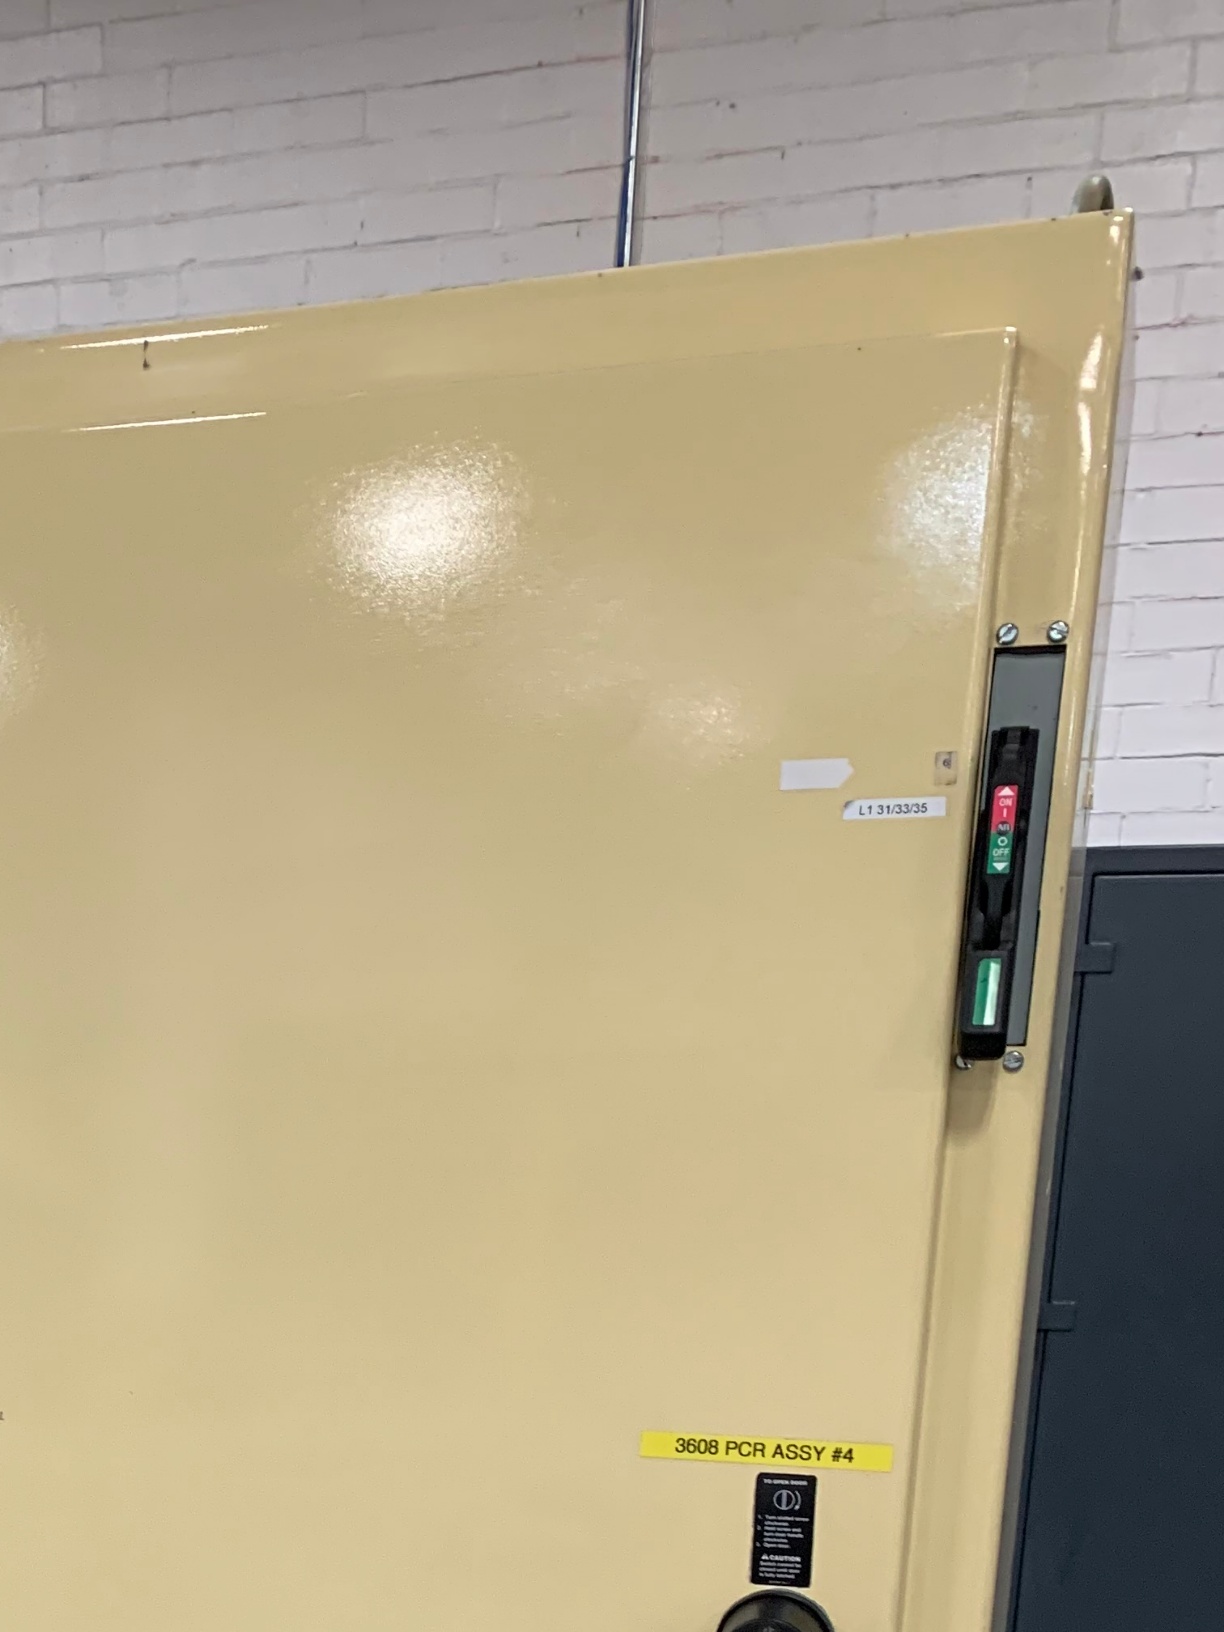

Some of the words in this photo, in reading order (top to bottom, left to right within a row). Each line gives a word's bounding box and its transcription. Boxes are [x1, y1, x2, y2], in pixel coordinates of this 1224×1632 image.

[998, 798, 1013, 807] ON
[859, 804, 873, 816] L1
[877, 803, 928, 815] 31/33/35
[992, 848, 1010, 857] OFF
[675, 1437, 719, 1455] 3608
[725, 1440, 766, 1458] PCR
[772, 1443, 826, 1461] ASSY
[831, 1447, 854, 1463] #4
[769, 1554, 801, 1562] CAUTION
